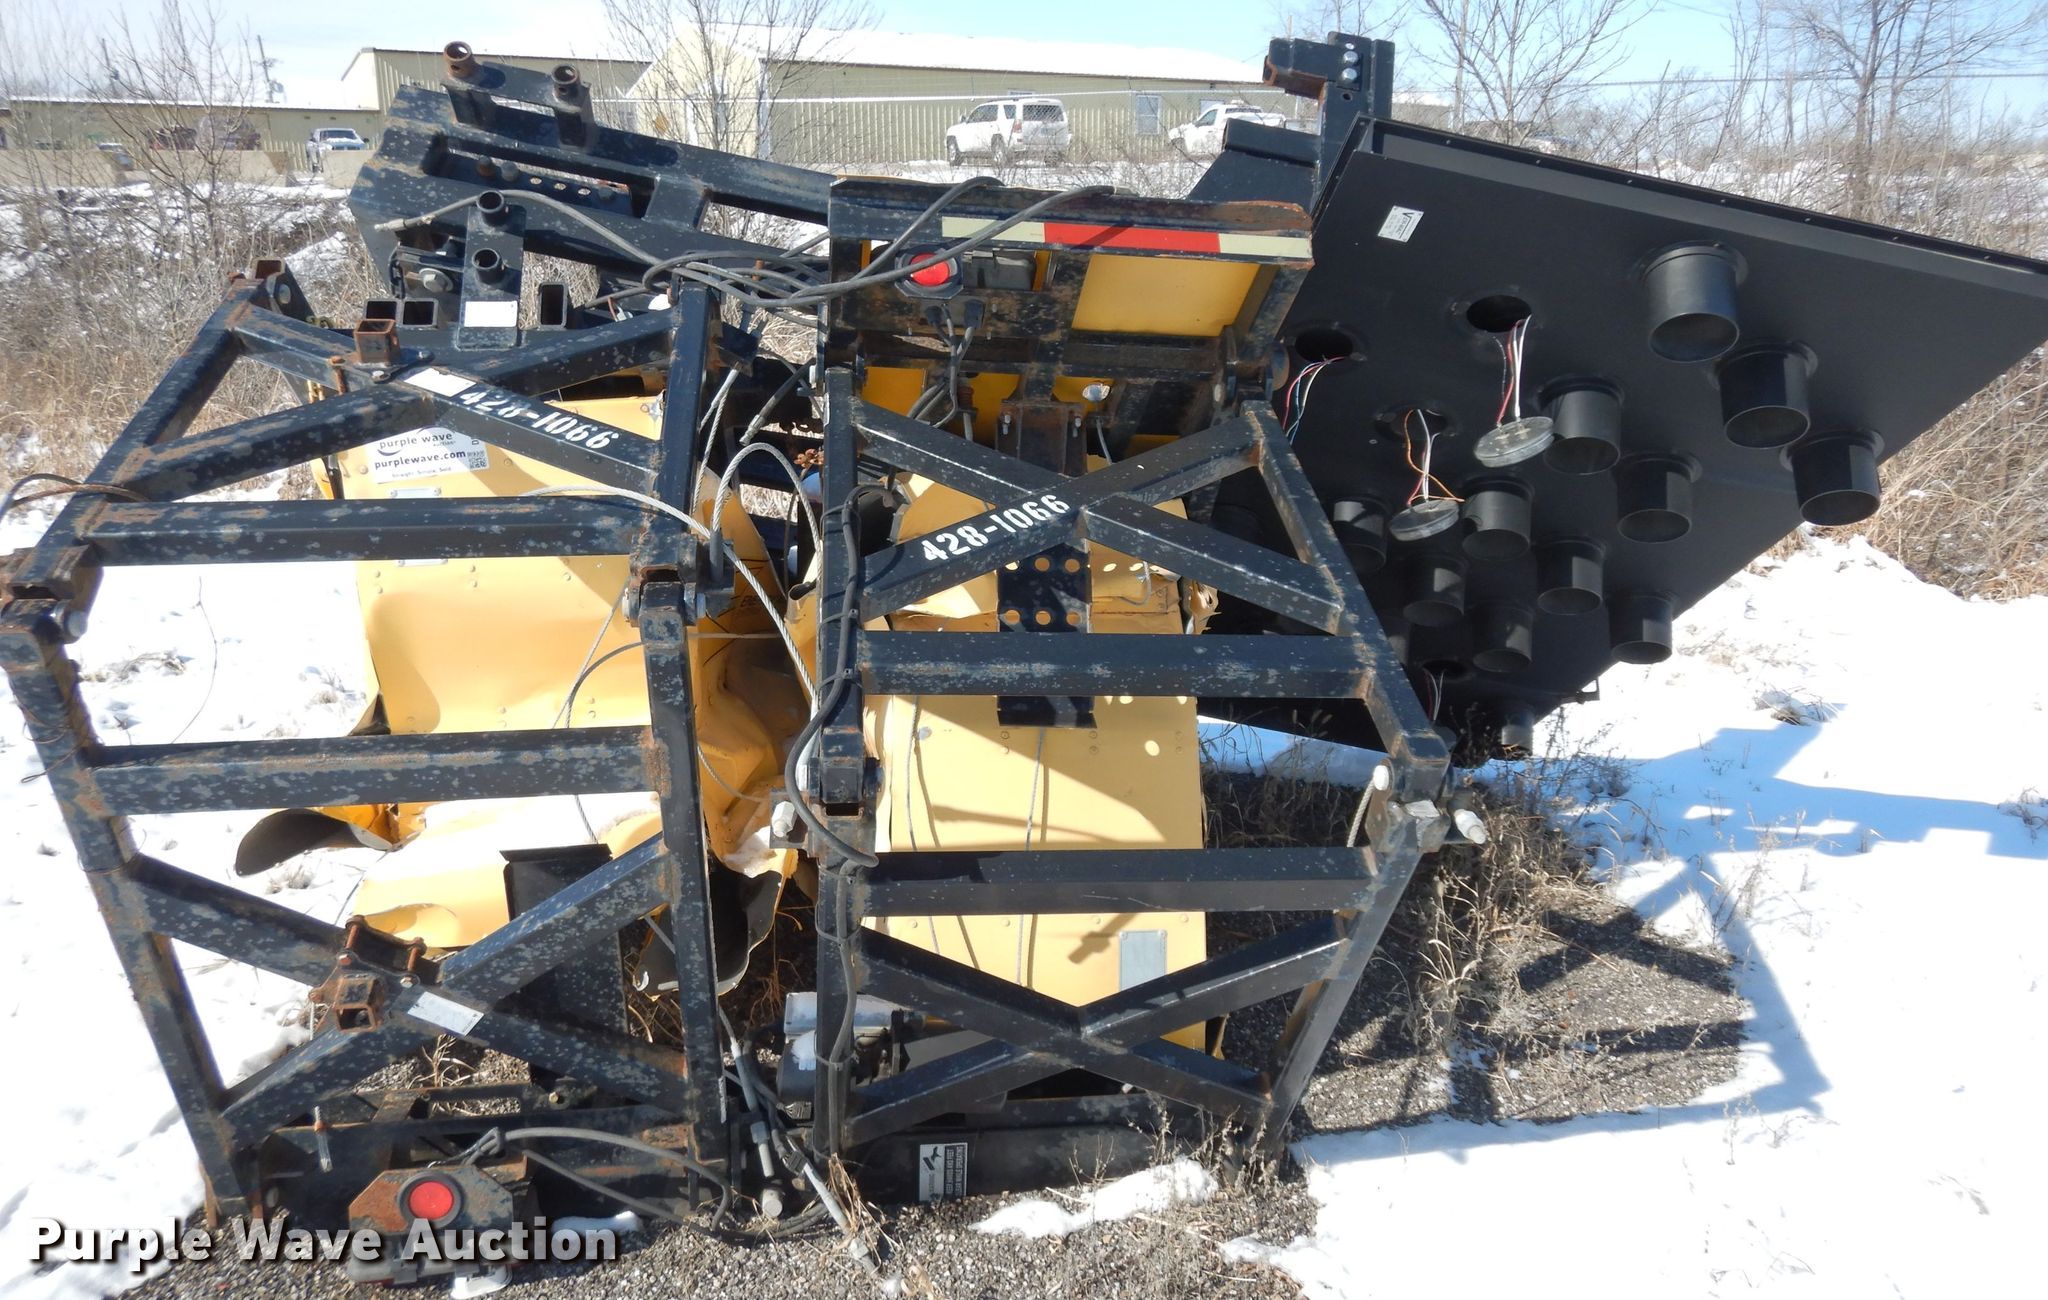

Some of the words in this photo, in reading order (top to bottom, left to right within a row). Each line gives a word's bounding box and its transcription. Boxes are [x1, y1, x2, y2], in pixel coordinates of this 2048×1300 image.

[459, 391, 620, 449] 428-1066
[374, 450, 467, 470] purplewave.com
[379, 437, 418, 450] purple
[421, 432, 453, 443] wave
[920, 493, 1071, 561] 428-1066
